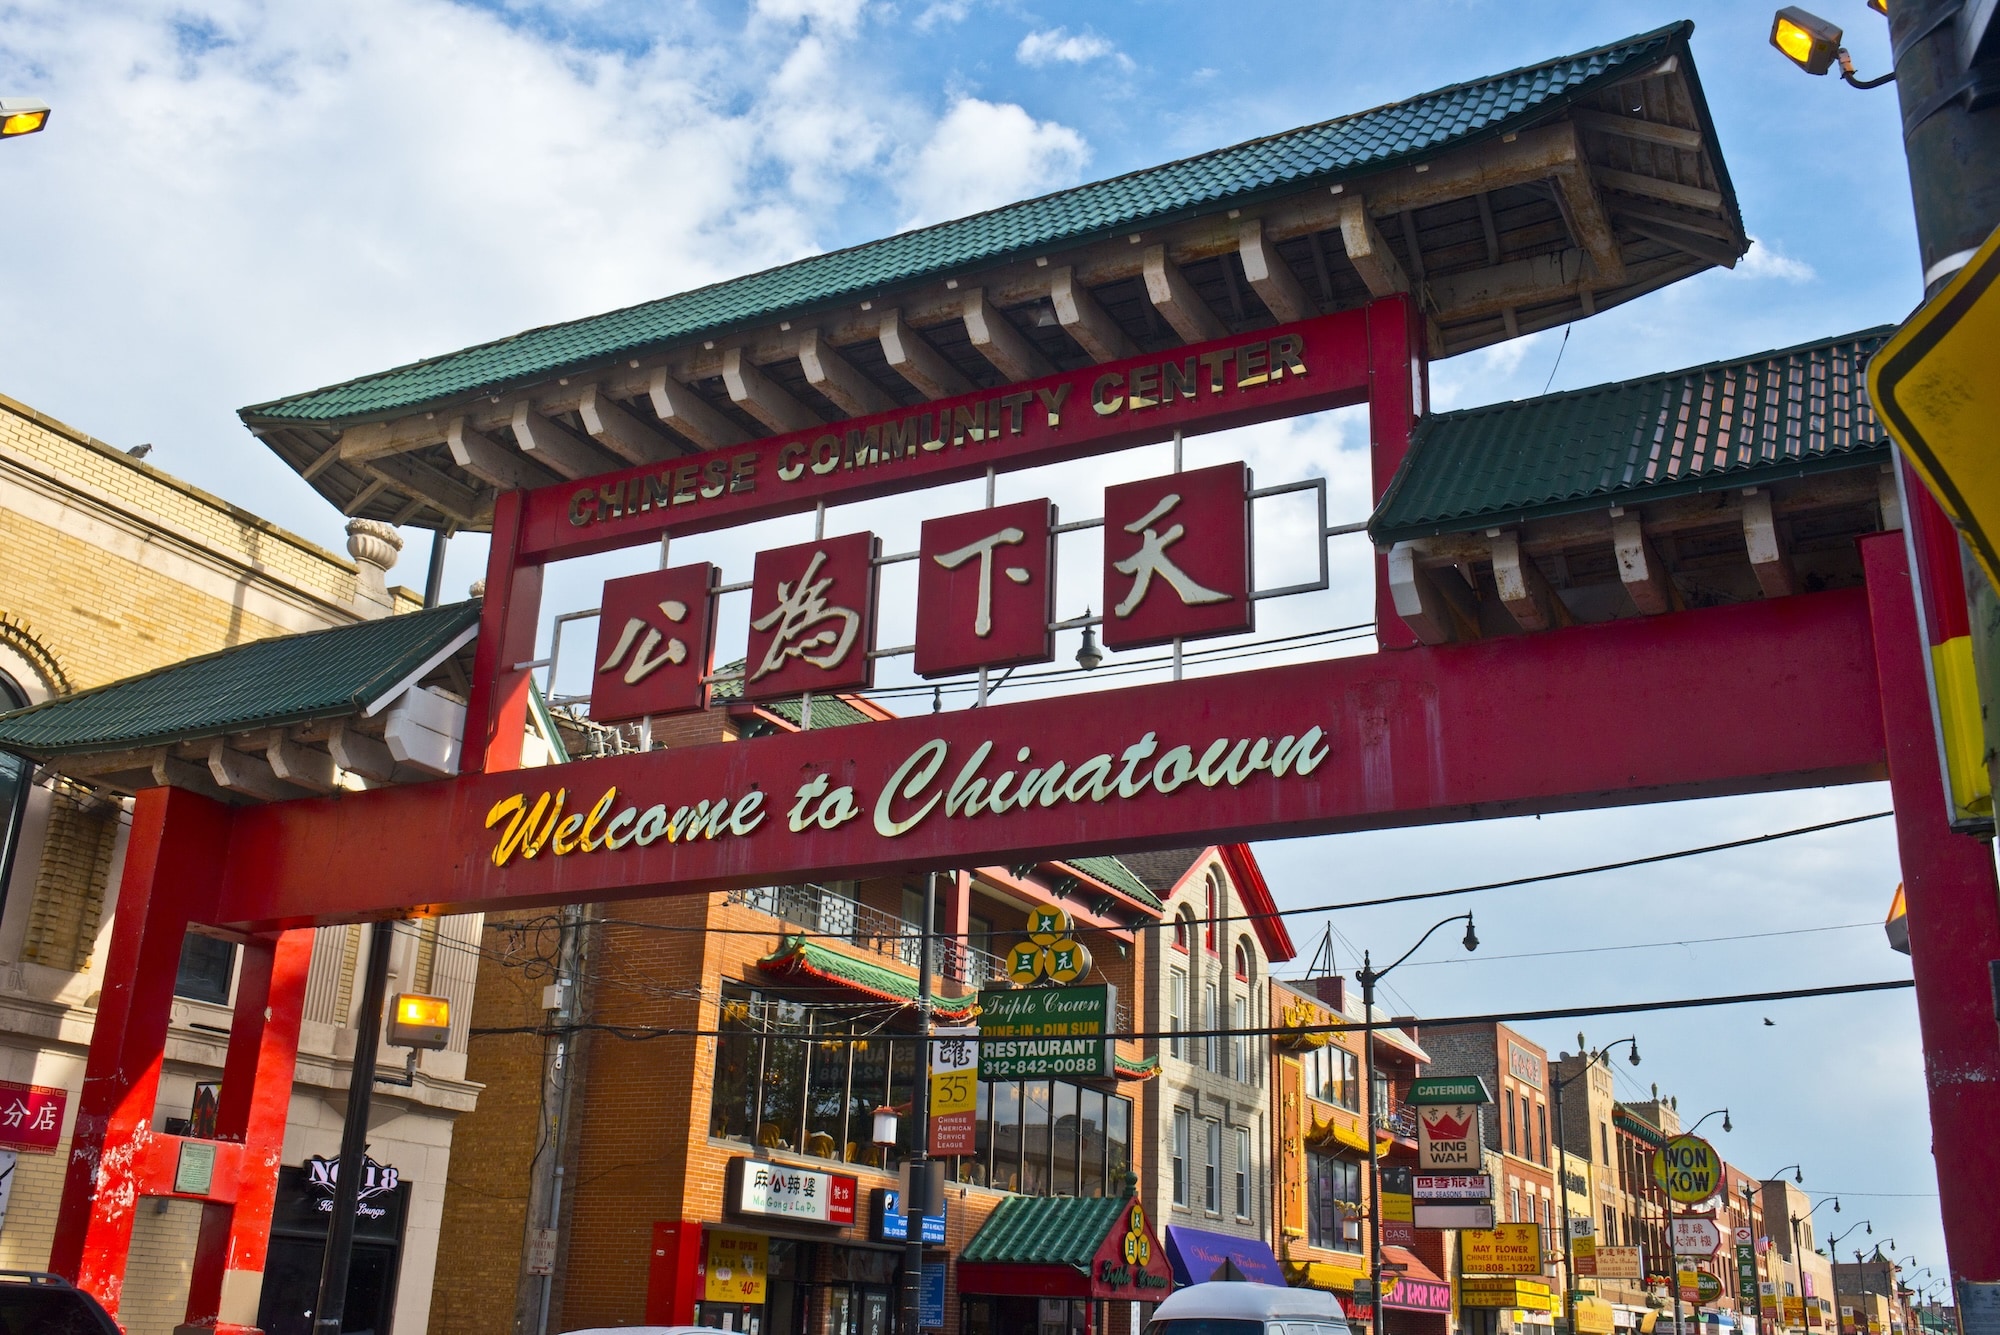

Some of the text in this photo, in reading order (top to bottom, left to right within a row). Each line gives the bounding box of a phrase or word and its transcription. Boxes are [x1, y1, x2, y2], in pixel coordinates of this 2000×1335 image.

[568, 332, 1307, 526] CHINESE COMMUNITY CENTER
[485, 724, 1330, 868] Welcome to Chinatown
[985, 992, 1101, 1022] Triple Crown
[983, 1021, 1099, 1037] DINE-IN DIM SUM
[983, 1039, 1097, 1058] RESTAURANT
[983, 1058, 1097, 1075] 312-842-0088
[1417, 1085, 1476, 1096] CATERING
[1430, 1141, 1467, 1152] KING
[1430, 1153, 1468, 1163] WAH
[1667, 1147, 1708, 1168] WON
[364, 1166, 398, 1189] 18
[1670, 1171, 1710, 1192] KOW
[356, 1203, 386, 1219] Lounge
[1385, 1229, 1411, 1239] CASL
[1473, 1245, 1528, 1254] MAY FLOWER
[1466, 1254, 1536, 1263] CHINESE RESTAURANT
[1467, 1264, 1485, 1272] (312)
